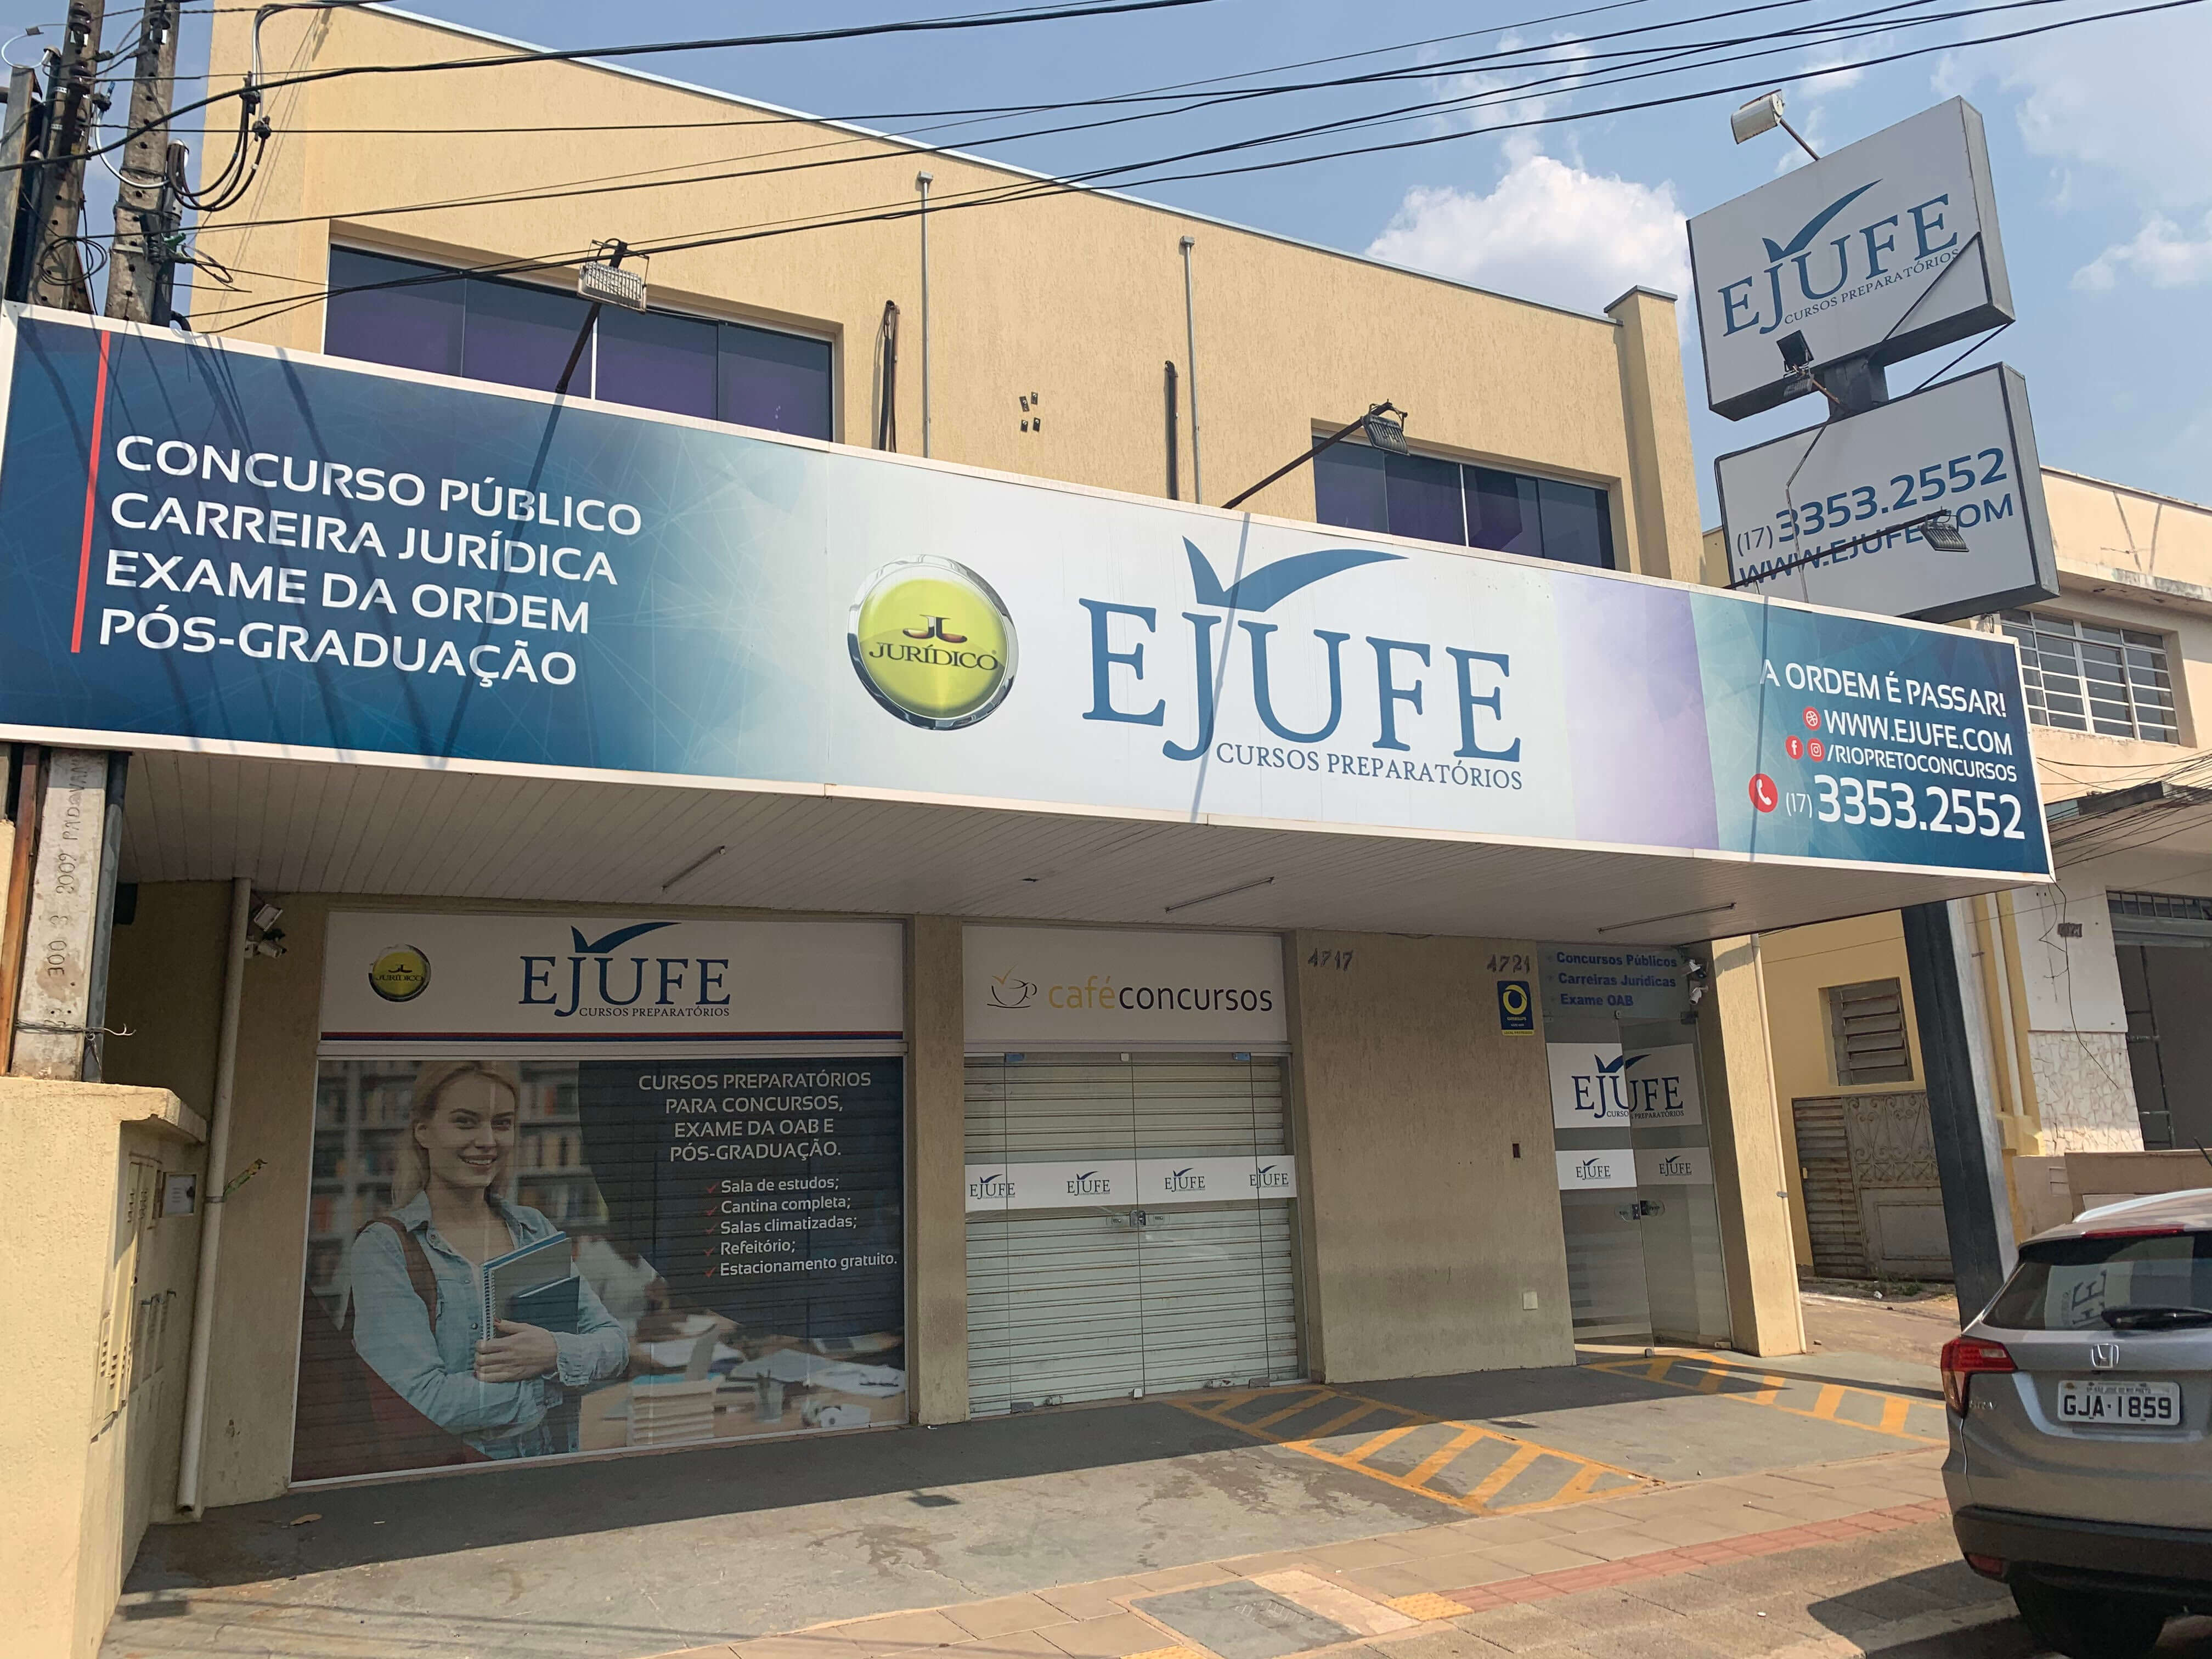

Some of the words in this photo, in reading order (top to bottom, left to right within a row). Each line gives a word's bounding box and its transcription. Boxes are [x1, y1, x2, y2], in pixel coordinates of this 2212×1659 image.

[1718, 193, 1958, 336] EJUFE
[1784, 296, 1837, 324] CURSOS
[1841, 249, 1959, 303] PREPARATÓRIOS
[116, 435, 425, 506] CONCURSO
[440, 476, 641, 536] PÚBLICO
[1736, 525, 1774, 557] (17)
[1776, 447, 2007, 543] 3353.2552
[111, 491, 386, 558] CARREIRA
[398, 527, 618, 585] JURÍDICA
[105, 549, 307, 605] EXAME
[322, 572, 398, 615] DA
[411, 583, 589, 634] ORDEM
[99, 604, 577, 687] PÓS-GRADUAÇÃO
[869, 641, 998, 671] JURÍDICO
[1079, 597, 1522, 762] EJUFE
[1760, 659, 1780, 687] A
[1785, 662, 1880, 701] ORDEM
[1886, 671, 1901, 703] É
[1906, 680, 2007, 718] PASSAR!
[1824, 709, 2013, 755] WWW.EJUFE.COM
[1216, 742, 1319, 771] CURSOS
[1327, 752, 1522, 790] PREPARATÓRIOS
[1827, 744, 2017, 782] /RIOPRETOCONCURSOS
[1786, 792, 1812, 819] (17)
[1814, 774, 2025, 840] 3353.2552
[57, 853, 76, 895] 2009
[1556, 951, 1623, 966] Concursos
[1626, 954, 1678, 968] Públicos
[518, 956, 730, 1017] EJUFE
[1558, 973, 1618, 986] Carreiras
[579, 1008, 628, 1017] CURSOS
[632, 1006, 730, 1017] PREPARATÓRIOS
[1560, 994, 1603, 1006] Exame
[1607, 994, 1634, 1006] OAB
[639, 1074, 718, 1091] CURSOS
[723, 1069, 872, 1089] PREPARATÓRIOS
[665, 1098, 717, 1114] PARA
[722, 1095, 843, 1113] CONCURSOS,
[1571, 1074, 1684, 1119] EJUFE
[675, 1121, 742, 1138] EXAME
[748, 1120, 775, 1136] DA
[779, 1119, 819, 1135] OAB
[823, 1118, 834, 1133] E
[670, 1138, 842, 1163] PÓS-GRADUAÇÃO.
[1249, 1172, 1290, 1189] EJUFE
[1576, 1165, 1611, 1181] EJUFE
[1658, 1162, 1692, 1177] EJUFE
[721, 1179, 753, 1193] Sala
[757, 1178, 774, 1192] de
[778, 1177, 839, 1191] estudos;
[969, 1182, 1016, 1199] EJUFE
[1067, 1180, 1111, 1196] EJUFE
[1164, 1176, 1206, 1193] EJUFE
[721, 1199, 777, 1214] Cantina
[781, 1196, 851, 1212] completa;
[720, 1220, 761, 1235] Salas
[764, 1216, 857, 1233] climatizadas;
[720, 1239, 796, 1255] Refeitório;
[720, 1257, 837, 1277] Estacionamento
[840, 1253, 898, 1271] gratuito.
